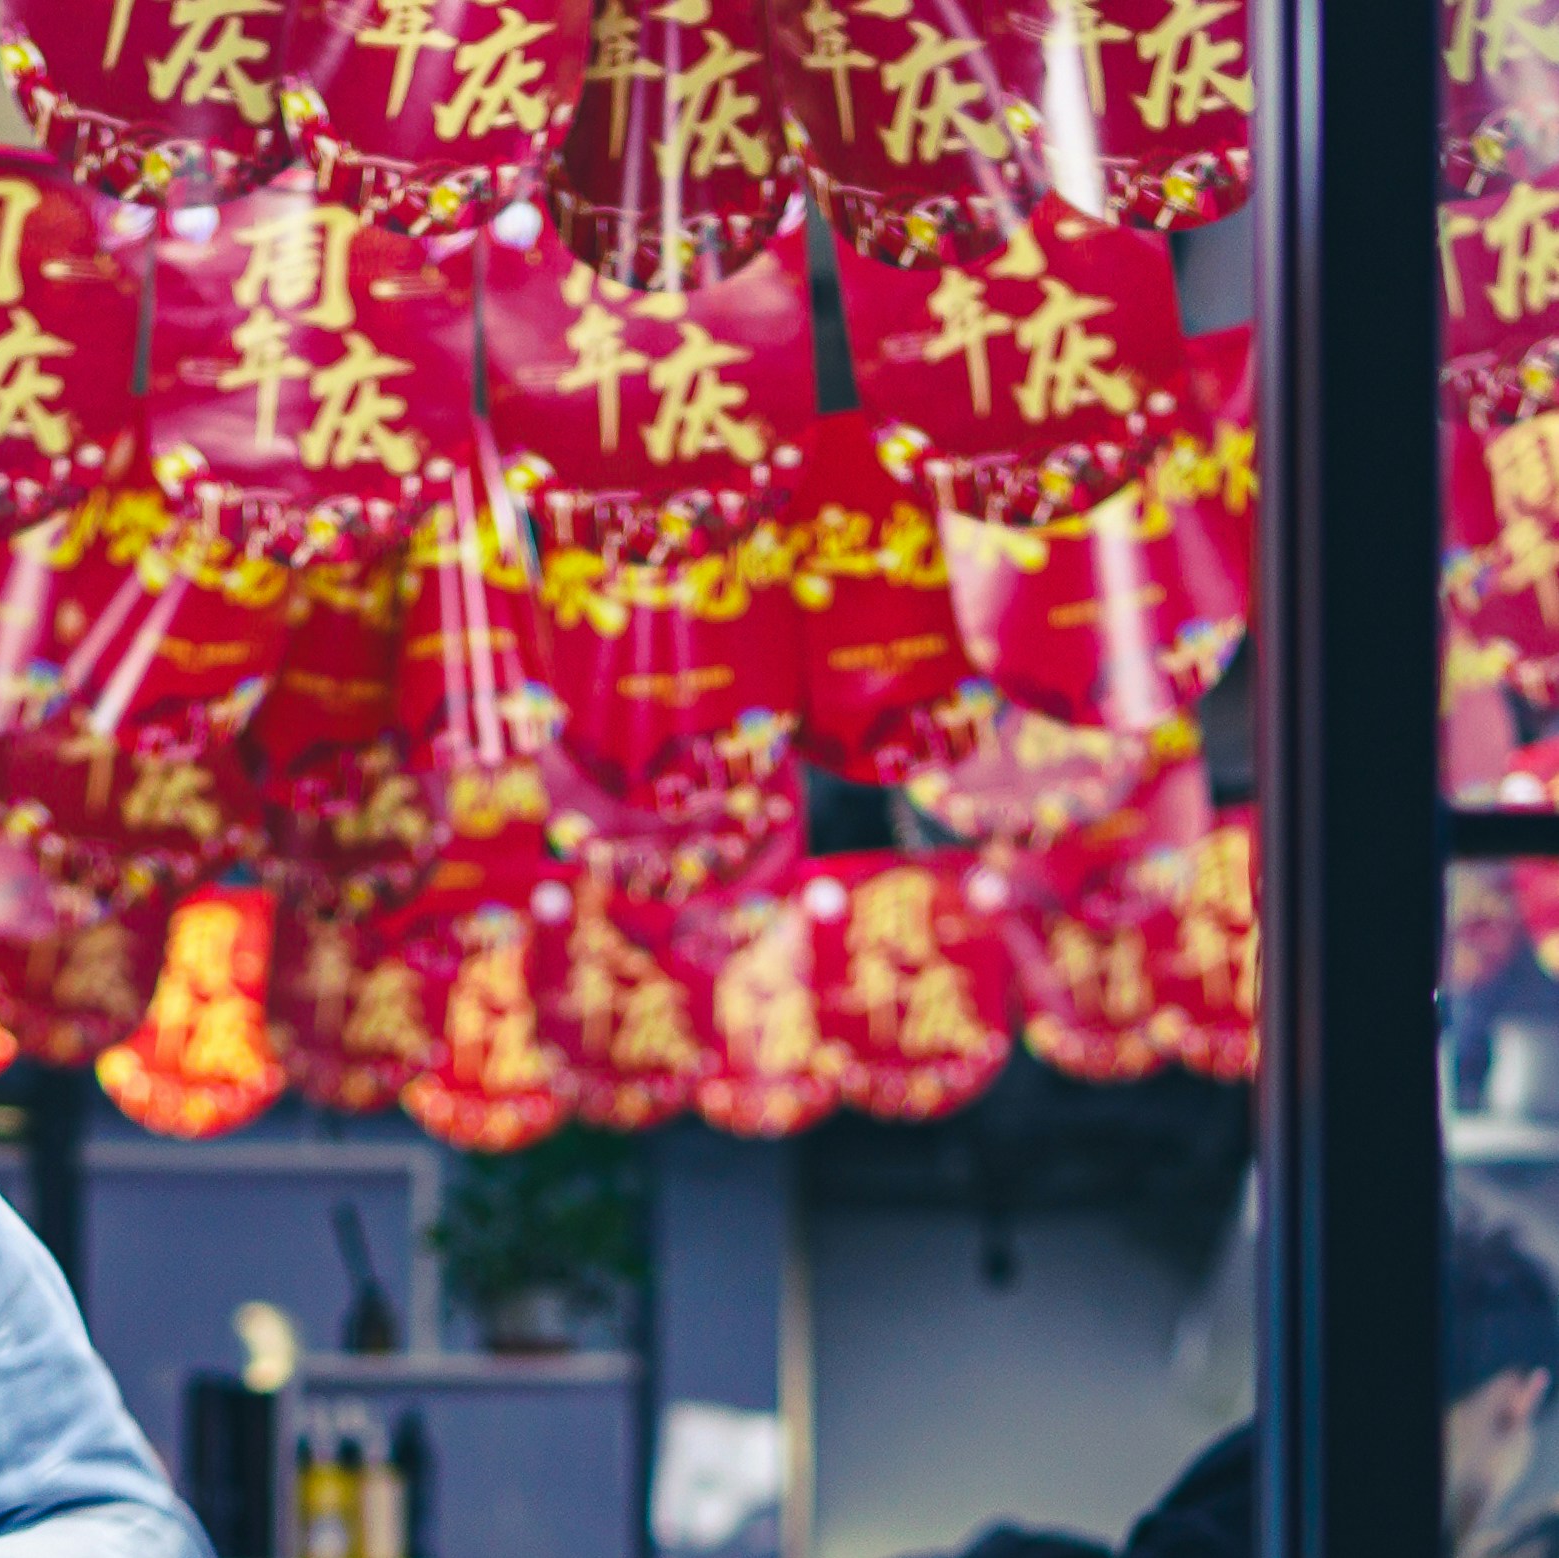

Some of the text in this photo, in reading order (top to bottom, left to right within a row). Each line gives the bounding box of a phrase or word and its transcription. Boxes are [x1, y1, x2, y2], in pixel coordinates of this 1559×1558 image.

[356, 0, 554, 138] 年庆
[585, 0, 772, 178] 年庆
[802, 0, 1010, 165] 年庆
[216, 205, 420, 476] 周年庆
